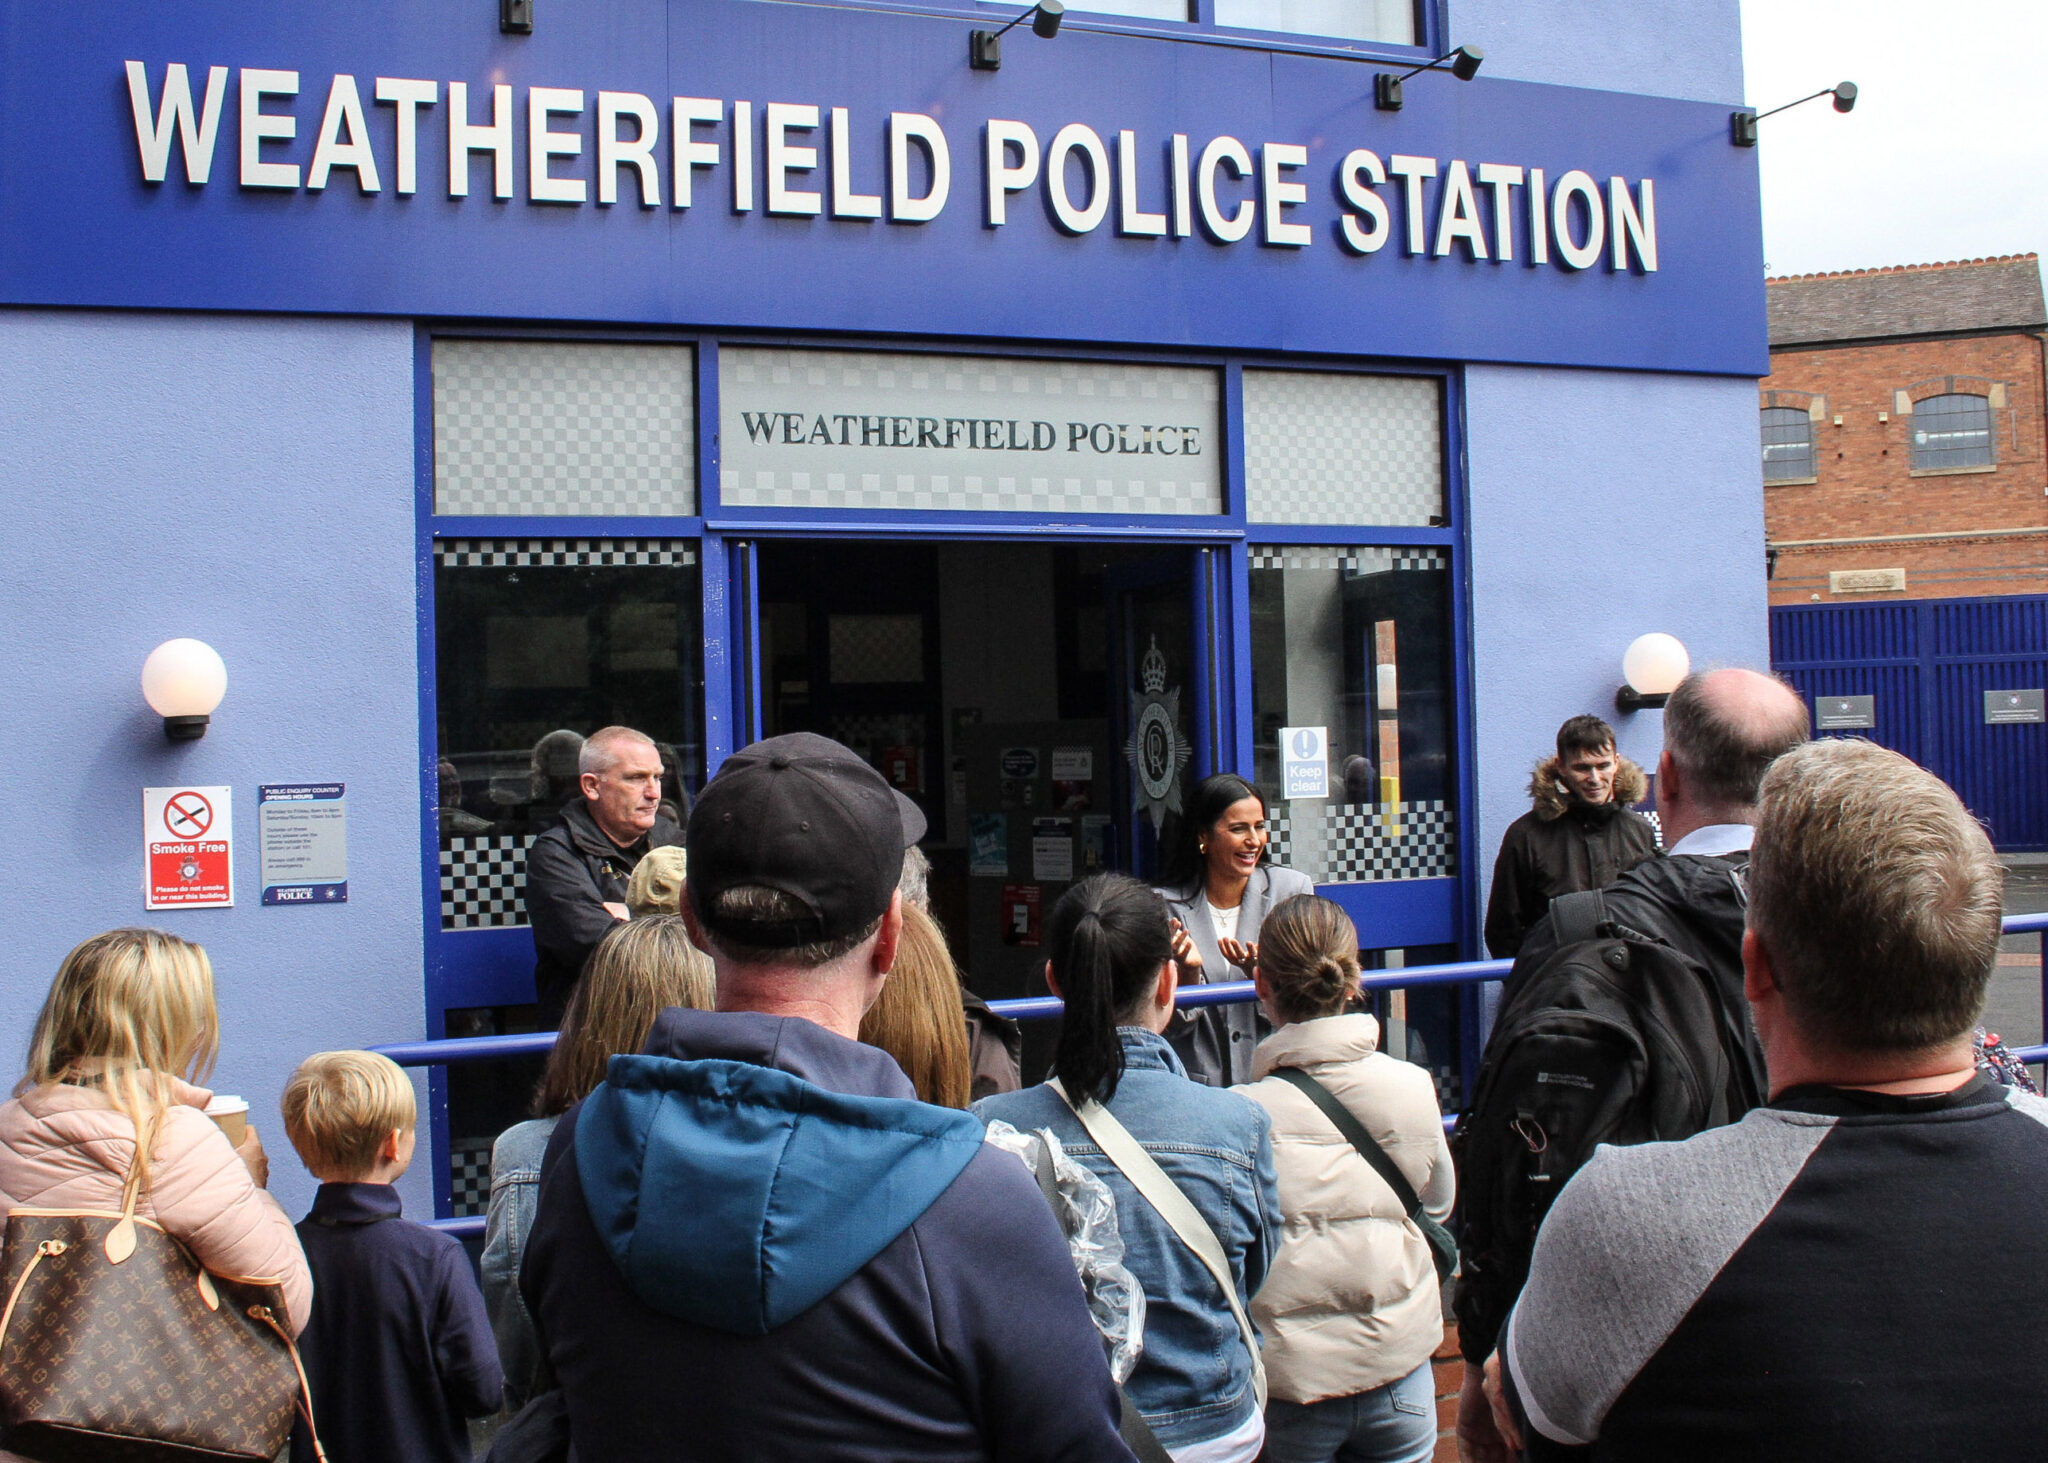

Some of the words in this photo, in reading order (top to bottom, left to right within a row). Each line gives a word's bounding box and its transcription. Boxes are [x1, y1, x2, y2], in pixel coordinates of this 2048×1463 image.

[123, 60, 951, 224] WEATHERFIELD
[986, 119, 1312, 248] POLICE
[1338, 149, 1658, 274] STATION
[741, 411, 1057, 452] WEATHERFIELD
[1066, 421, 1202, 456] POLICE
[1290, 765, 1322, 779] Keep
[1291, 780, 1322, 792] clear
[152, 843, 195, 854] Smoke
[198, 842, 226, 852] Free
[277, 892, 314, 900] POLICE
